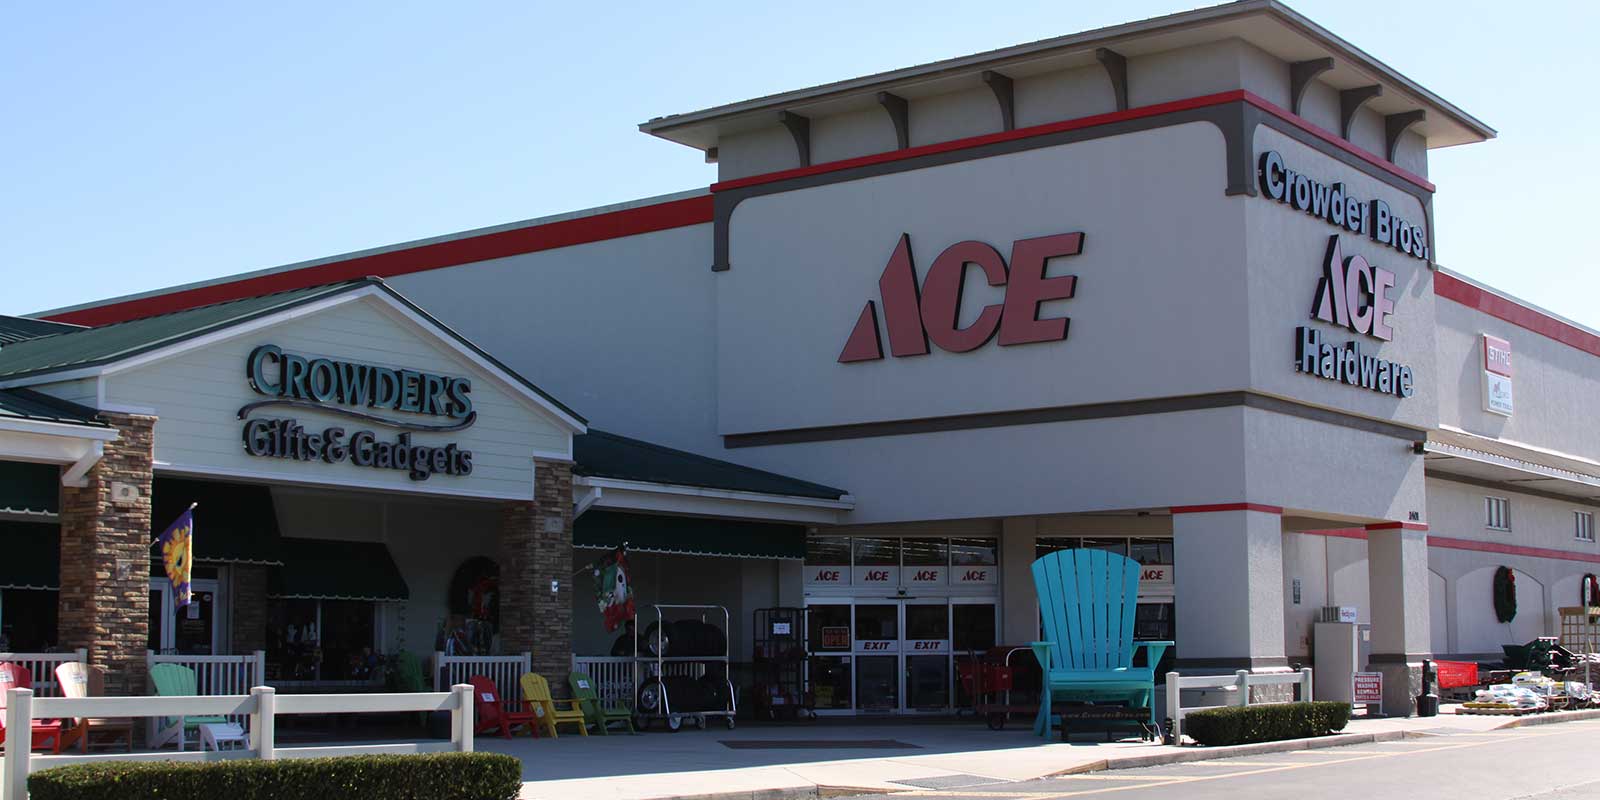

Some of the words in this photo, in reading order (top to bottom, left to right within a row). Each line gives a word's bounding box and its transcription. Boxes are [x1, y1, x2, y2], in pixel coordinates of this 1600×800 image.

[1259, 150, 1369, 236] Crowder
[1369, 199, 1430, 261] Bros.
[1310, 234, 1396, 342] ACE
[837, 231, 1086, 363] ACE
[1295, 326, 1414, 399] Hardware
[246, 343, 473, 419] CROWDER'S
[815, 570, 840, 582] ACE
[864, 570, 889, 582] ACE
[913, 570, 938, 582] ACE
[962, 570, 987, 582] ACE
[1140, 569, 1164, 581] ACE
[863, 641, 891, 650] EXIT
[914, 641, 941, 650] EXIT
